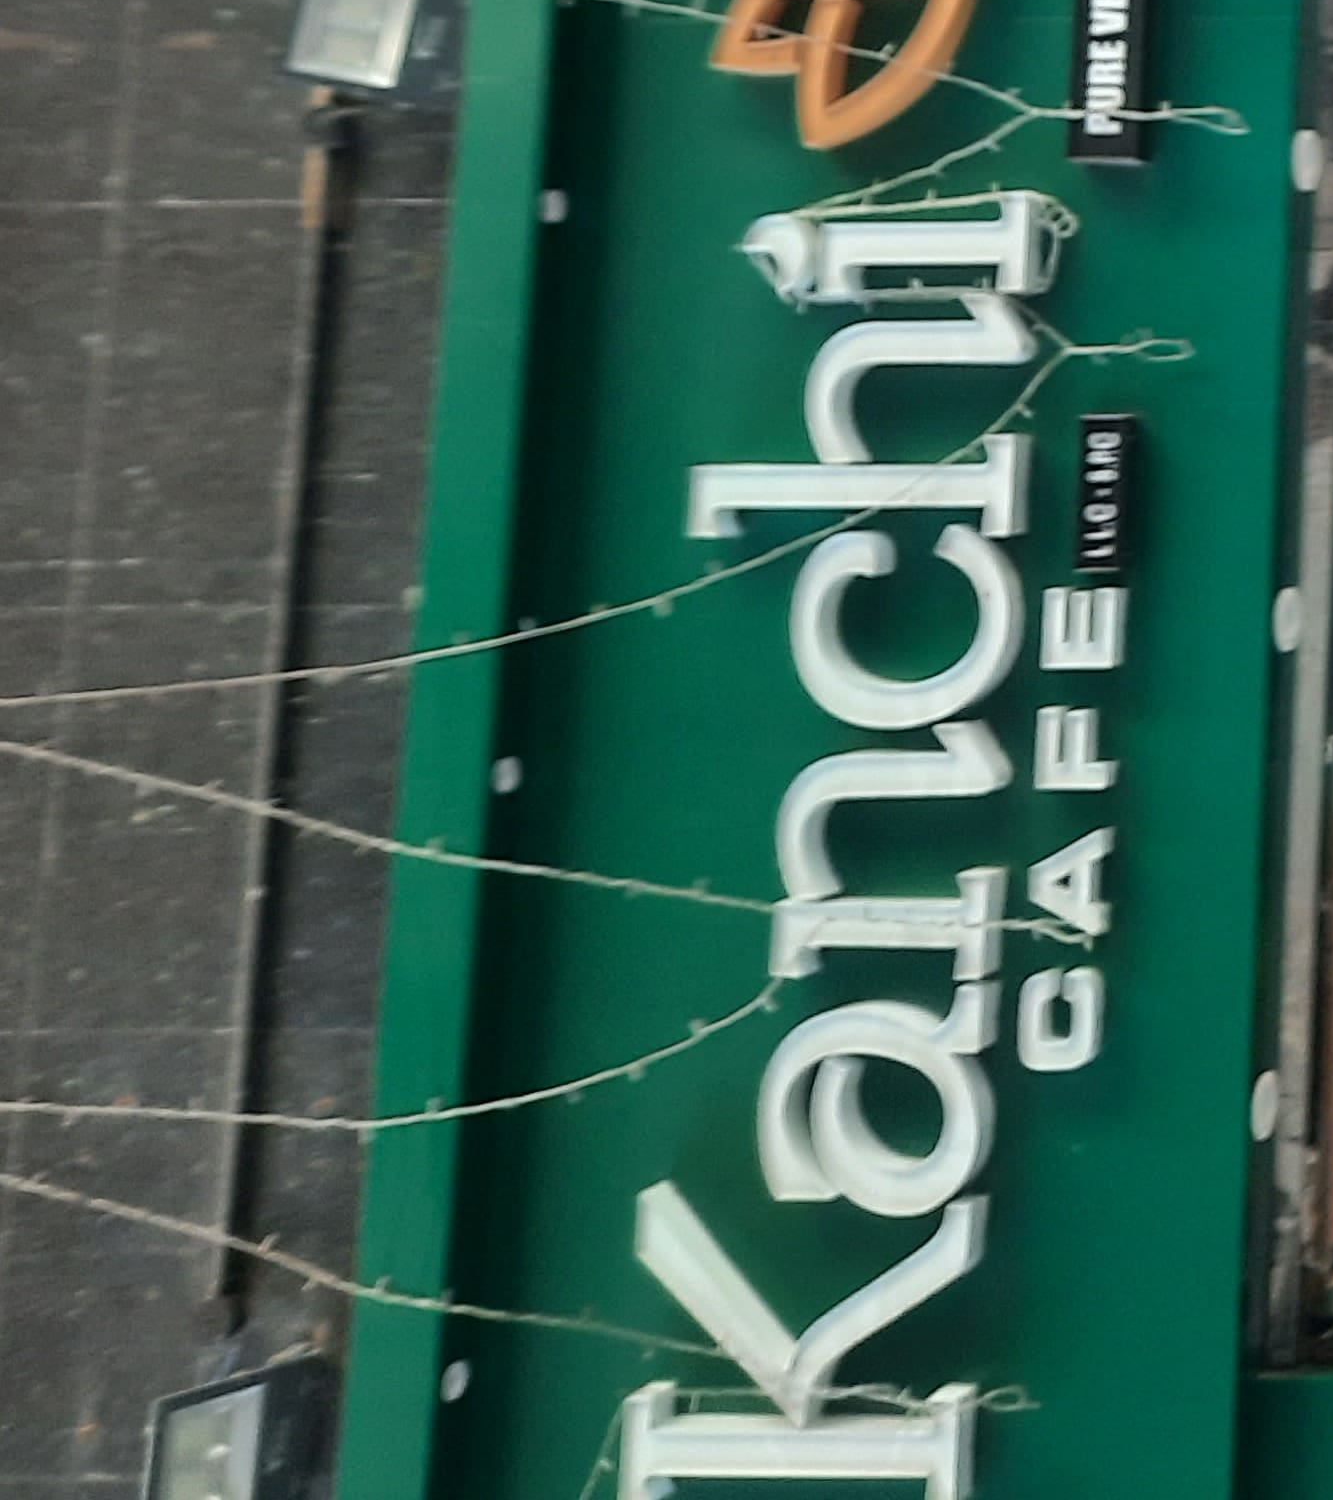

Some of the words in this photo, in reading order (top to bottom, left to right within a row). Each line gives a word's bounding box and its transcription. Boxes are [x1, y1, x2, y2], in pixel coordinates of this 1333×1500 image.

[1083, 39, 1127, 136] PURE
[617, 191, 1052, 1500] Kanchi
[1016, 586, 1128, 1072] CAFE
